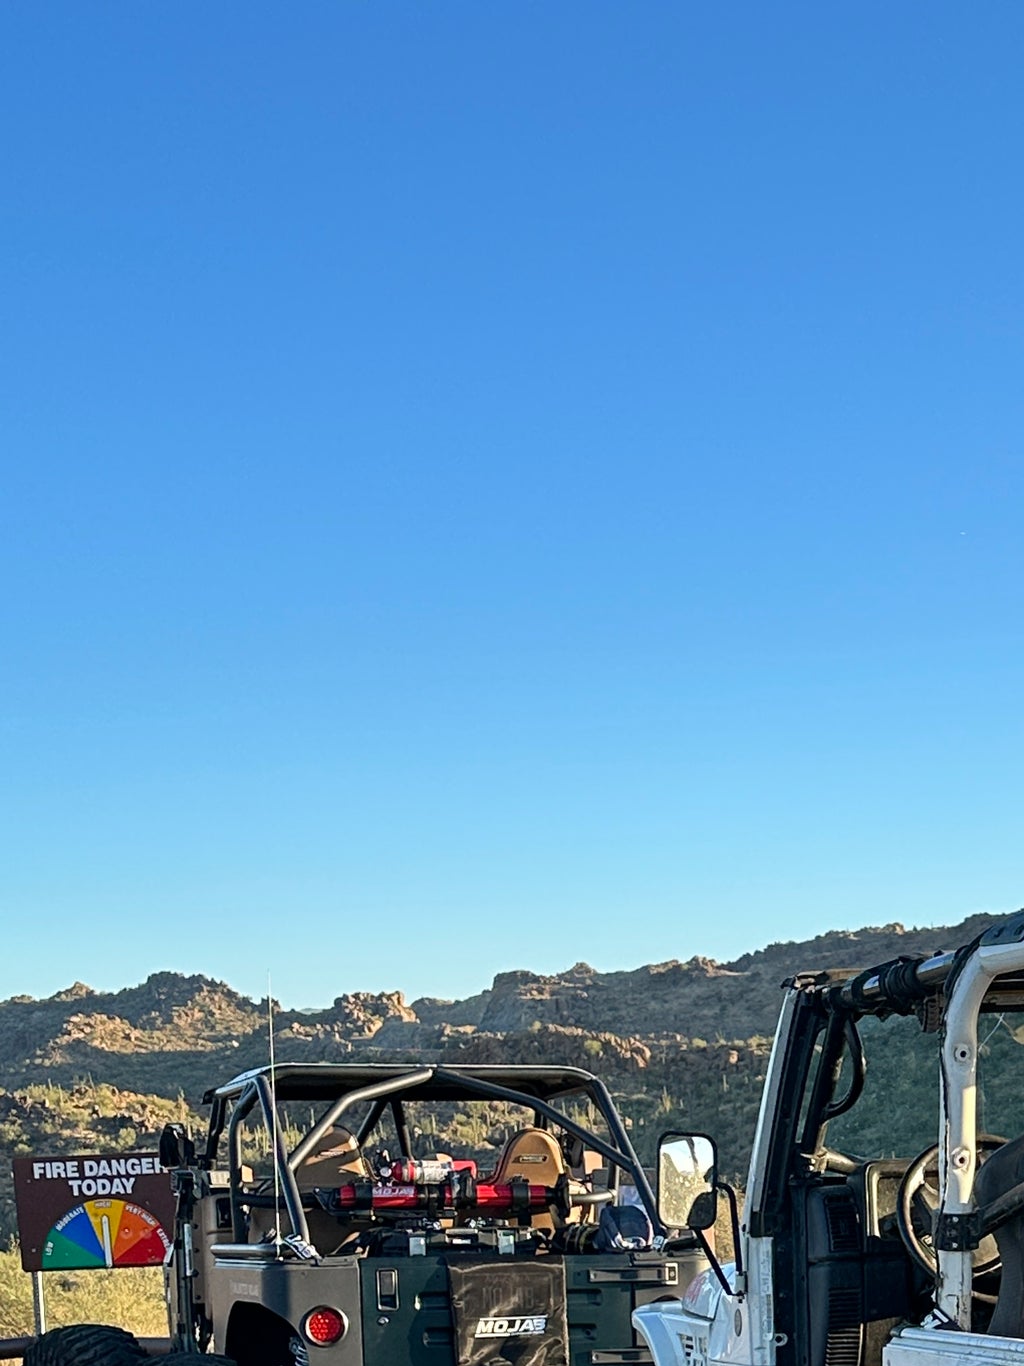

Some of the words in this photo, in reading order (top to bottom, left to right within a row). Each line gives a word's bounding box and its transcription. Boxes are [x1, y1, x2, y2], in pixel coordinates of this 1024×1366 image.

[33, 1161, 80, 1179] FIRE
[83, 1157, 169, 1177] DANGER
[68, 1177, 136, 1196] TODAY
[475, 1318, 547, 1334] MOJAB
